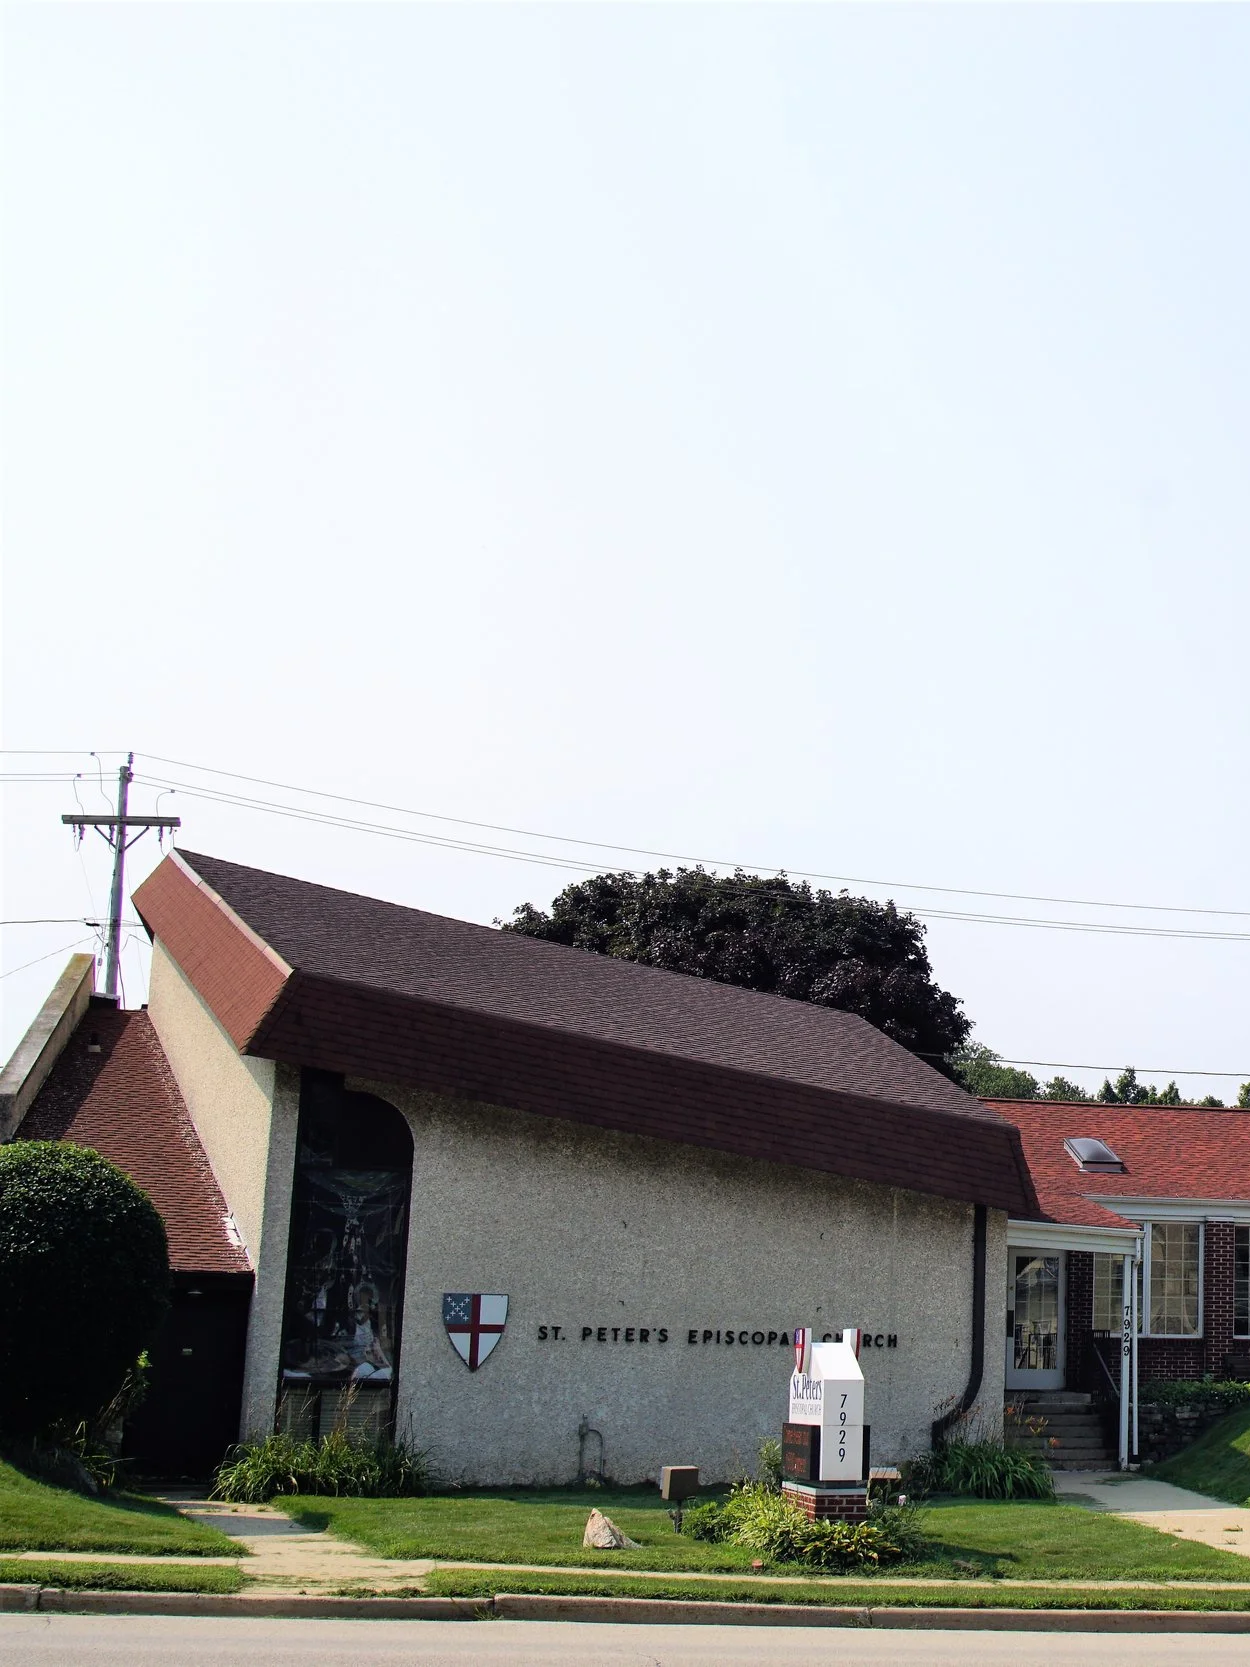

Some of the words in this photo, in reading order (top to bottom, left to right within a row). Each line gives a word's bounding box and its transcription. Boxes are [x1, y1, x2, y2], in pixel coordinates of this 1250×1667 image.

[538, 1326, 566, 1341] ST.
[581, 1327, 669, 1343] PETER'S
[688, 1329, 790, 1346] EPISCOPA
[822, 1332, 898, 1348] CHRCH
[1123, 1306, 1131, 1356] 7929
[838, 1394, 848, 1463] 7929
